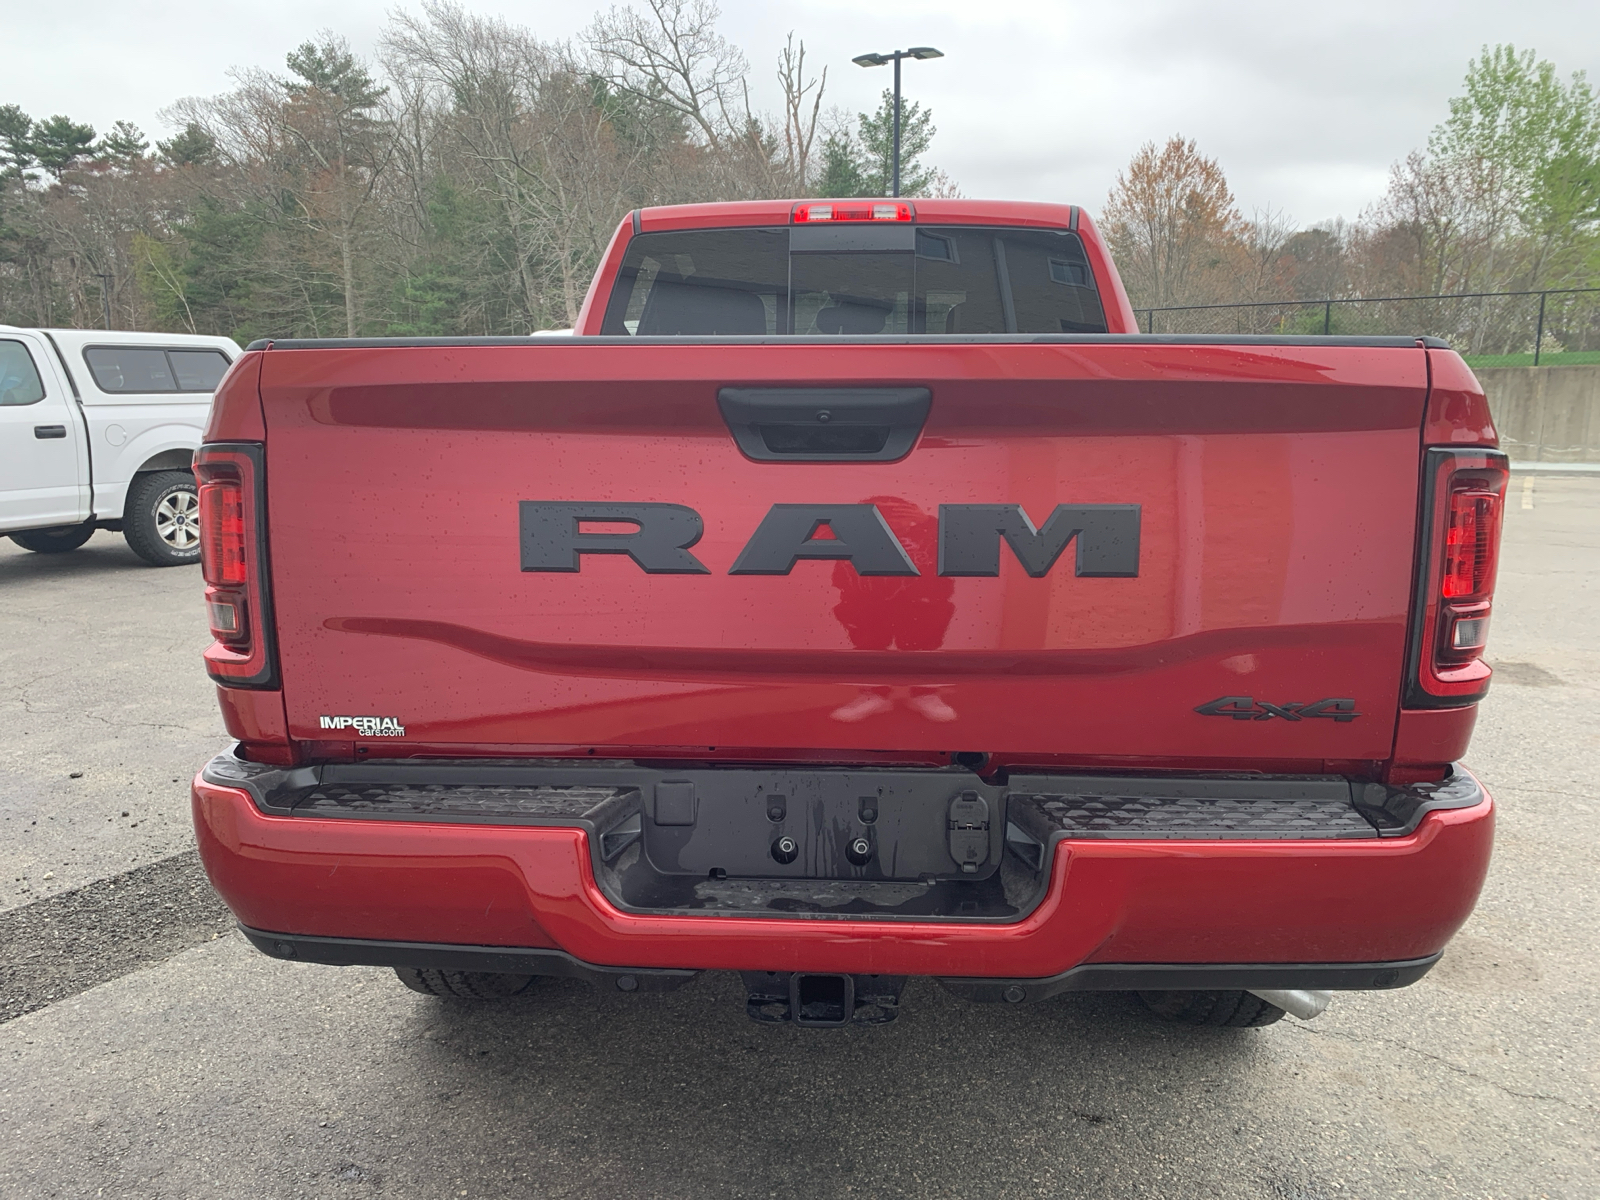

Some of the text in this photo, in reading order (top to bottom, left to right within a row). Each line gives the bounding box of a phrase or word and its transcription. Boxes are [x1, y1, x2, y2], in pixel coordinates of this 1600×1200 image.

[519, 500, 1142, 578] RAM
[170, 547, 201, 556] OPER
[1193, 695, 1363, 723] 4x4
[319, 715, 405, 730] IMPERIAL
